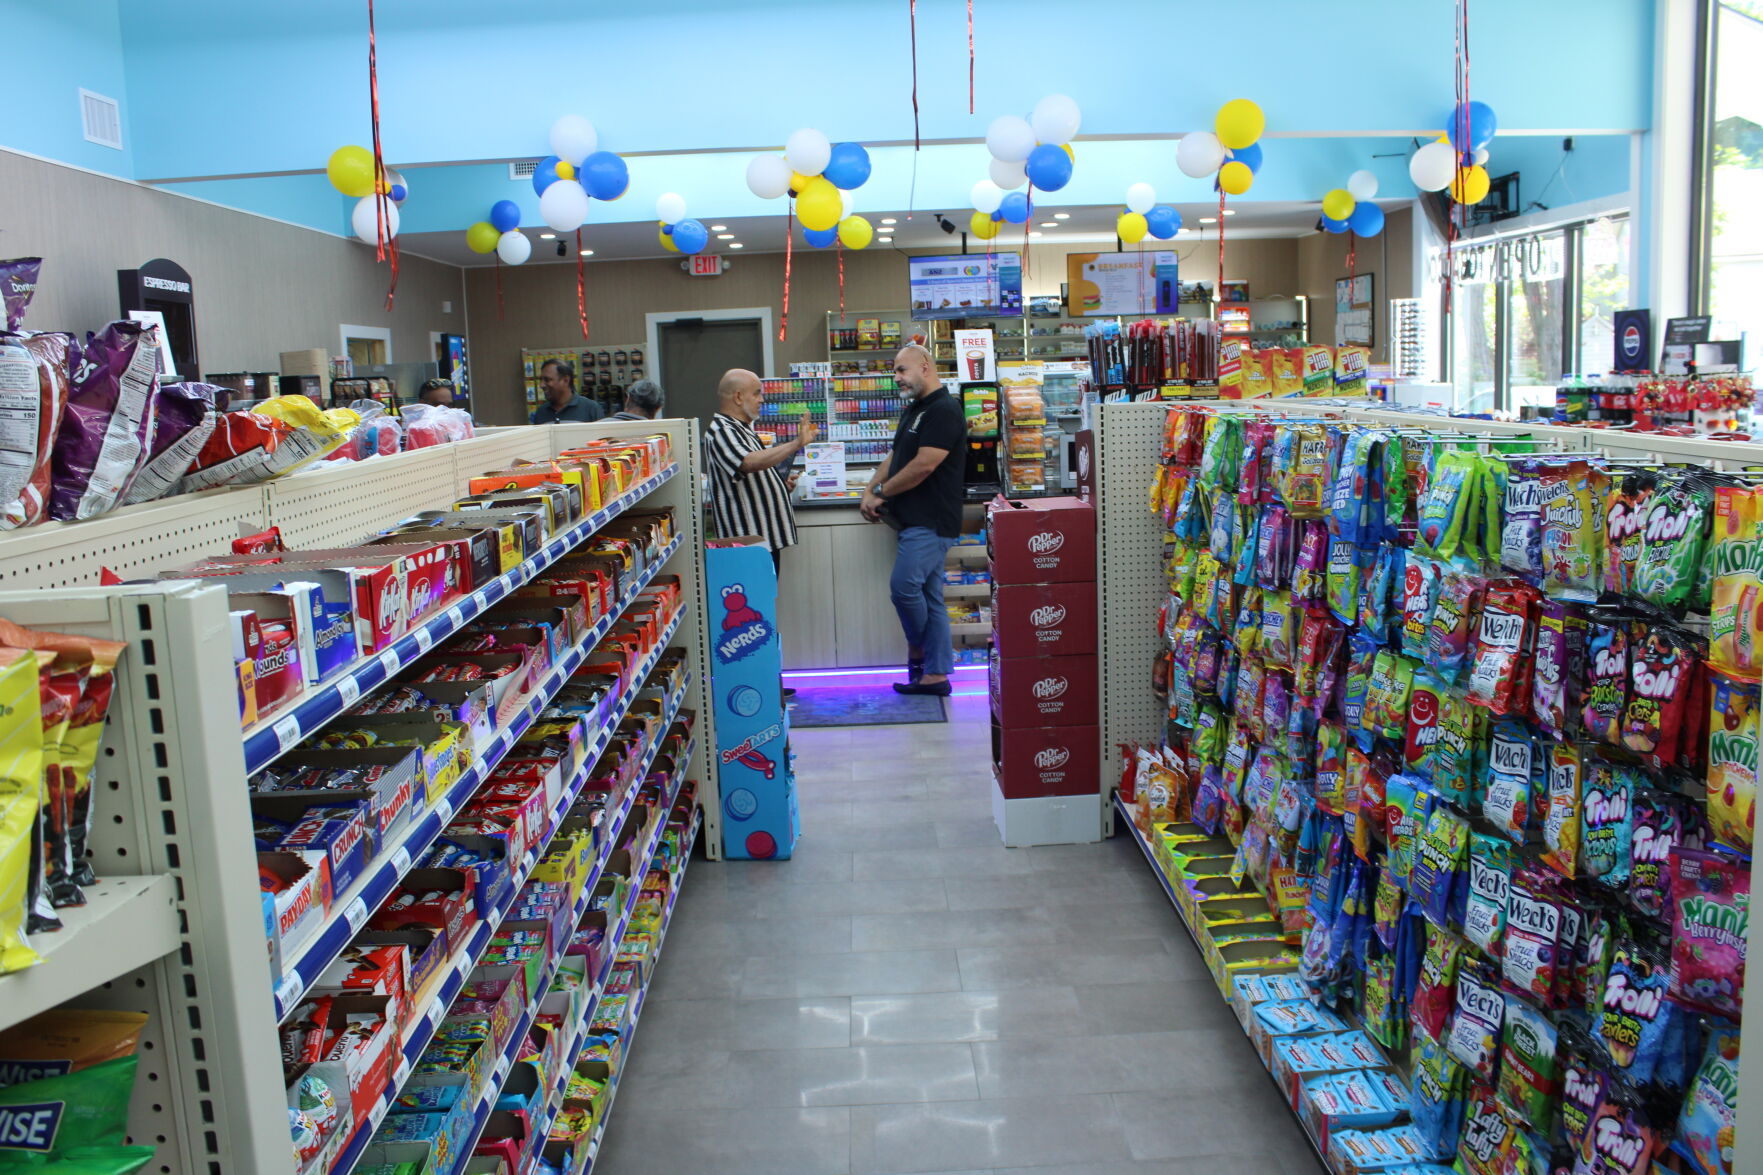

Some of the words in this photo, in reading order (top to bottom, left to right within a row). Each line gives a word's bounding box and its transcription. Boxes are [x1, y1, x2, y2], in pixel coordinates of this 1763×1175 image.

[695, 255, 718, 274] EXIT
[144, 276, 177, 291] ESPRESSO
[177, 281, 190, 293] BAR
[962, 337, 988, 346] FREE
[1104, 388, 1126, 404] WILD
[1135, 388, 1158, 404] WILD
[1647, 503, 1696, 541] Trolli
[1031, 534, 1061, 553] Pepper
[1040, 532, 1054, 542] Dr
[1033, 608, 1063, 626] Pepper
[1043, 605, 1055, 616] Dr
[1484, 616, 1522, 642] Wech's
[1712, 615, 1736, 631] STRIPS
[1036, 680, 1065, 698] Pepper
[1045, 678, 1057, 687] Dr
[1632, 661, 1680, 698] Tolli
[1437, 725, 1467, 755] PUNCH
[1038, 751, 1067, 769] Pepper
[1047, 748, 1059, 757] Dr
[1494, 742, 1529, 770] Wech's
[380, 778, 411, 833] Chunky
[1400, 815, 1414, 826] AIR
[333, 813, 365, 864] CRUNCH
[1392, 825, 1414, 837] HEADS
[1426, 836, 1451, 855] SOUR
[1632, 825, 1678, 861] Trlli
[1419, 839, 1451, 874] PUNCH
[1472, 862, 1508, 899] Wech's
[280, 882, 312, 935] PAYDAY
[1509, 897, 1555, 933] Wech's
[1460, 981, 1501, 1020] Wech's
[1604, 974, 1663, 1020] Trolli
[1516, 1061, 1535, 1082] BEARS
[1475, 1100, 1508, 1143] Laffy
[1465, 1119, 1494, 1163] Taffy
